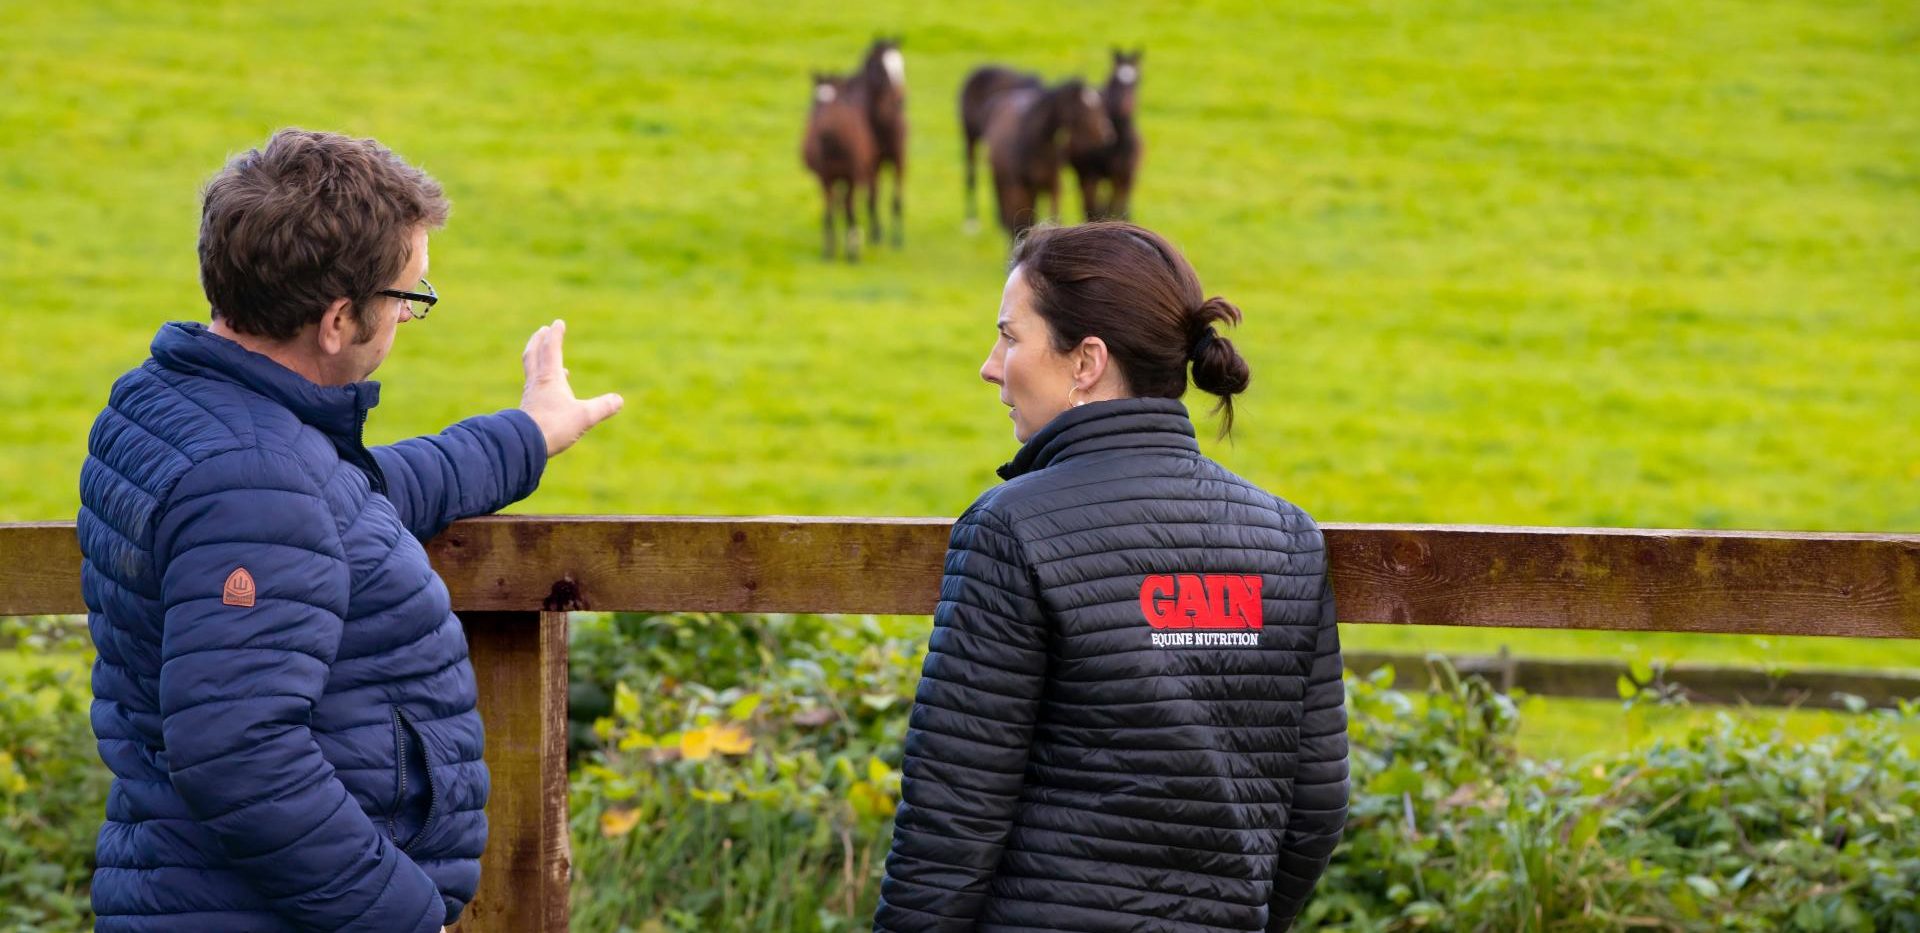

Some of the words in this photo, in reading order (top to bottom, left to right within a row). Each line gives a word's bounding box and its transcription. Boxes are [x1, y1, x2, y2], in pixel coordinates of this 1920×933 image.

[1140, 574, 1263, 629] GAIN
[1151, 633, 1193, 647] EQUINE
[1195, 633, 1259, 646] NUTRITION
